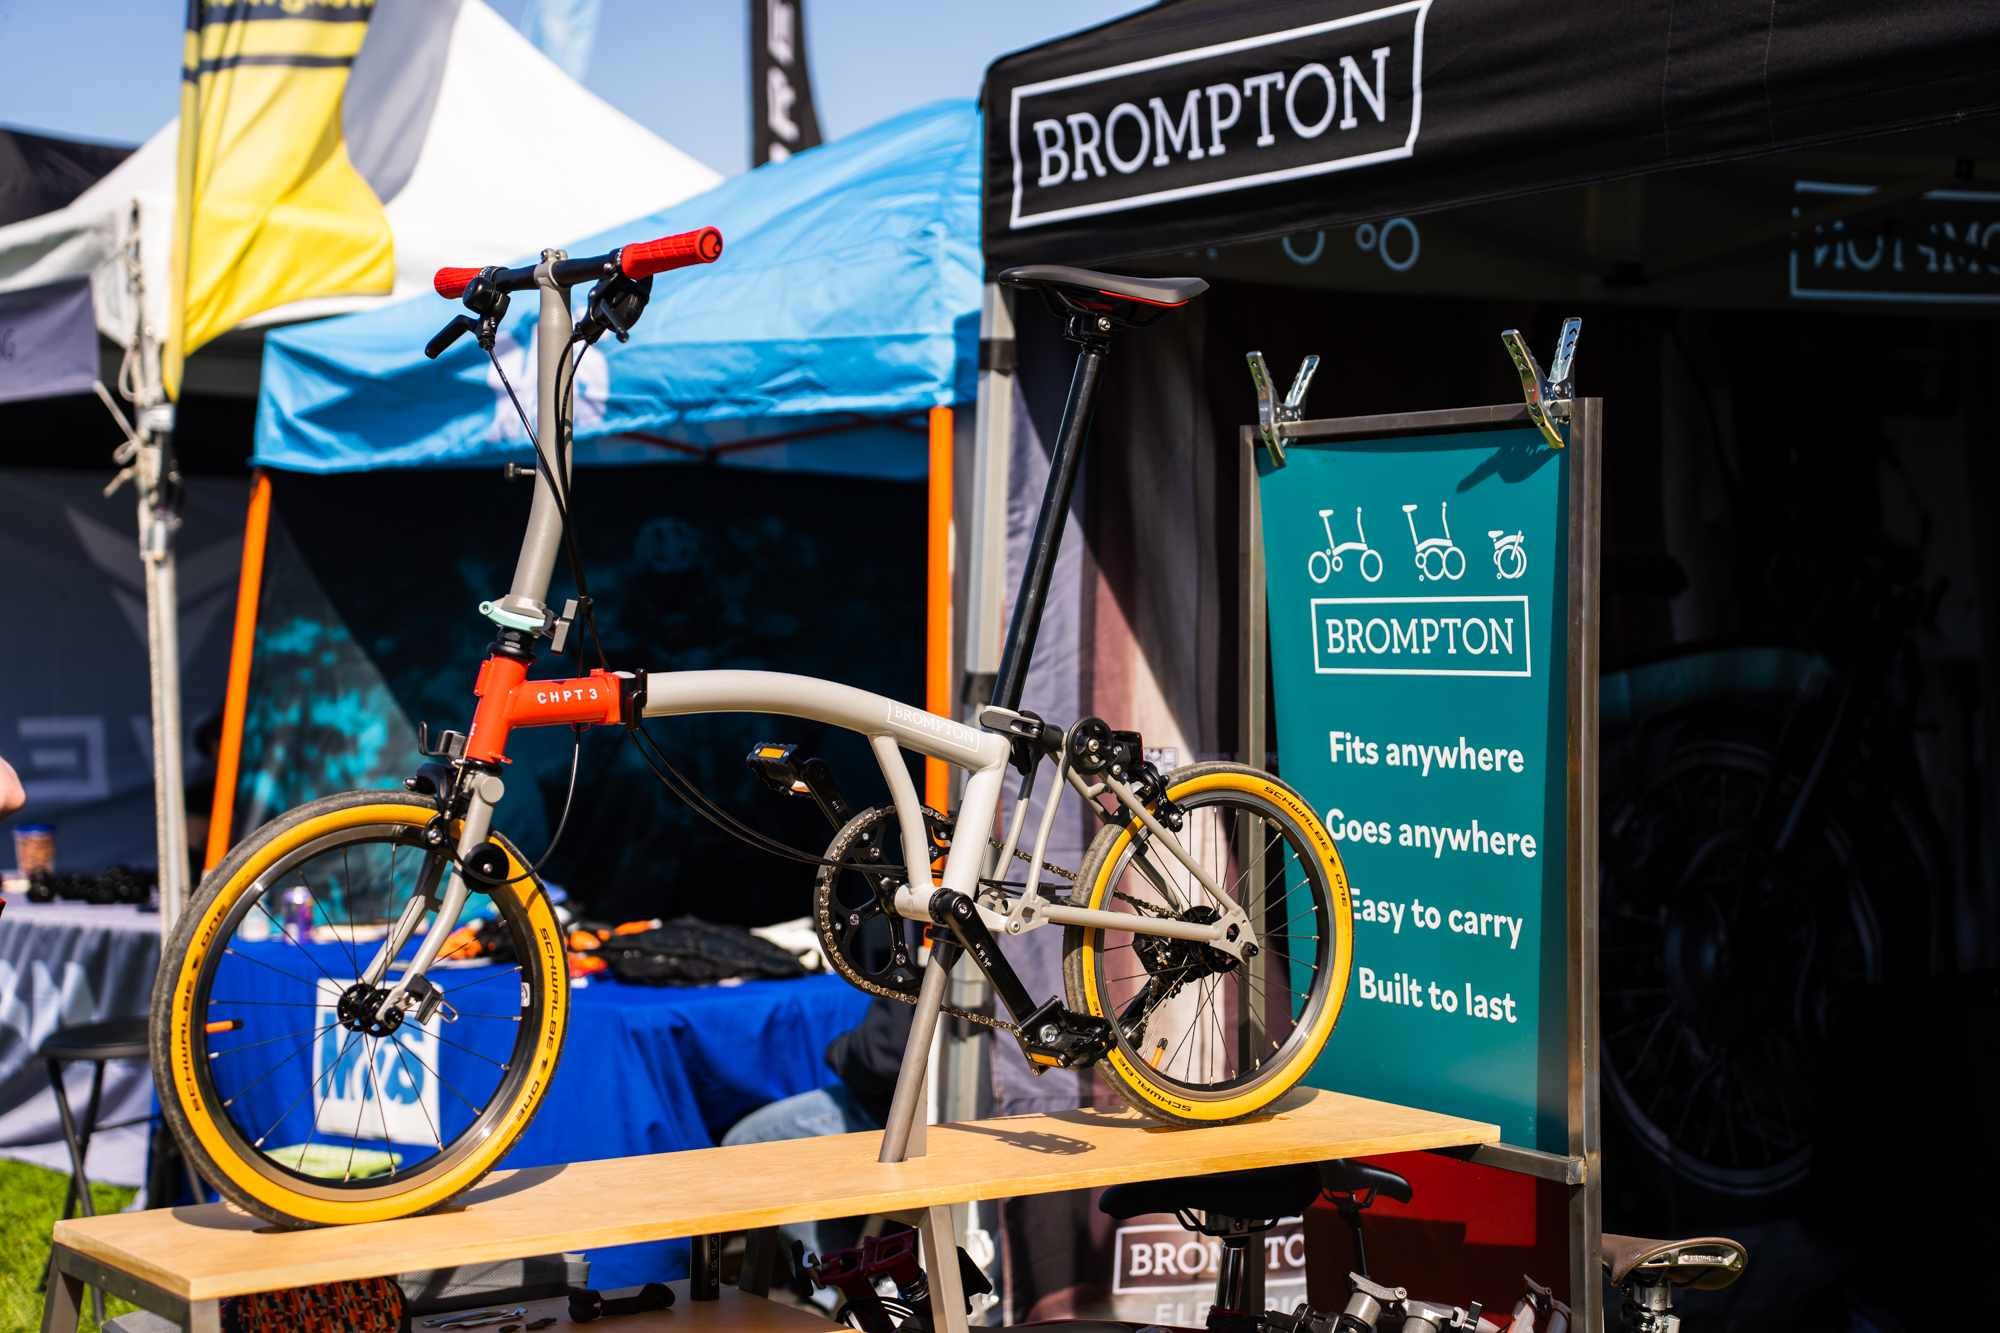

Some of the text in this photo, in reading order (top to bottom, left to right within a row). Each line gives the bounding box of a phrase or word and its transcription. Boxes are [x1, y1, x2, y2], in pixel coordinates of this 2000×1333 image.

[1032, 46, 1391, 187] BROMPTON
[1325, 617, 1514, 655] BROMPTON
[537, 688, 598, 704] CHPT 3
[894, 705, 975, 743] BROMPTON
[1329, 730, 1524, 777] Fits anywhere
[1263, 786, 1330, 851] SCHWALBE
[1325, 808, 1537, 859] Goes anywhere
[1349, 887, 1406, 934] Easy
[1410, 898, 1442, 930] to
[1448, 909, 1523, 950] carry
[539, 927, 558, 1051] SCHWALBE
[1358, 966, 1518, 1024] Built to last
[1117, 1057, 1192, 1113] SCHWALBE
[1128, 1232, 1306, 1277] BROTO
